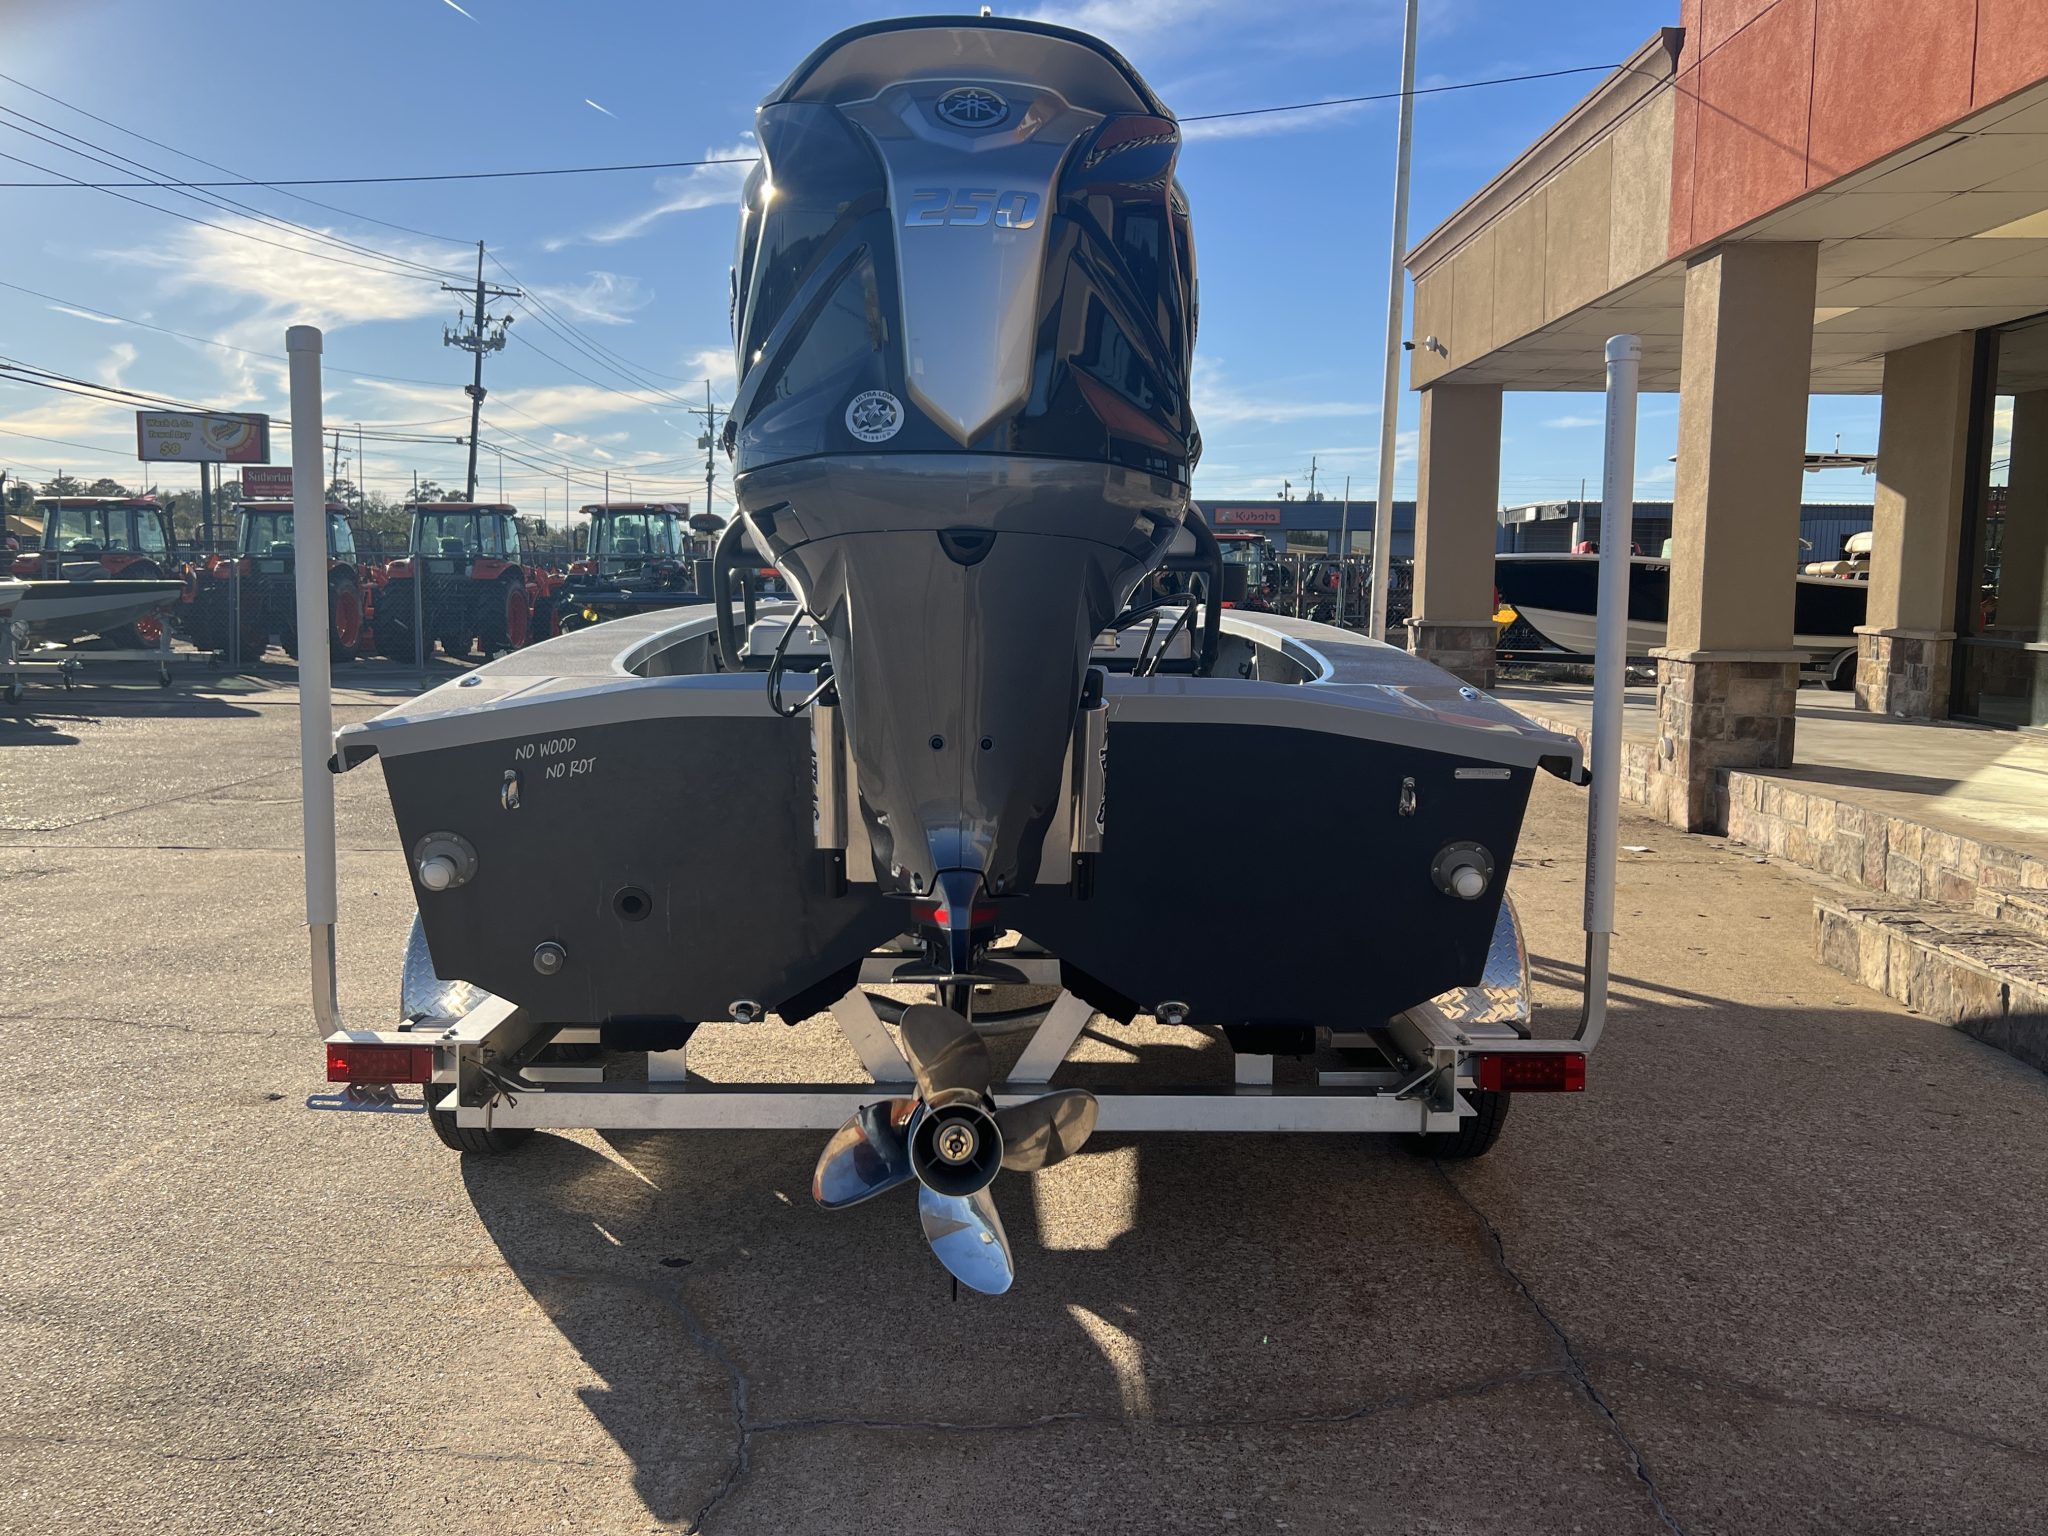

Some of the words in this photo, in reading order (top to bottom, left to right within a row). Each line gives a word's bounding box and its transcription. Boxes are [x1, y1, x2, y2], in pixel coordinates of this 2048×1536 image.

[903, 187, 1042, 231] 250
[855, 391, 877, 403] ULTRA
[878, 392, 895, 402] LOW
[1235, 511, 1276, 521] Kubota
[515, 743, 535, 760] NO
[540, 738, 577, 757] WOOD
[545, 763, 566, 779] NO
[569, 757, 597, 778] ROT
